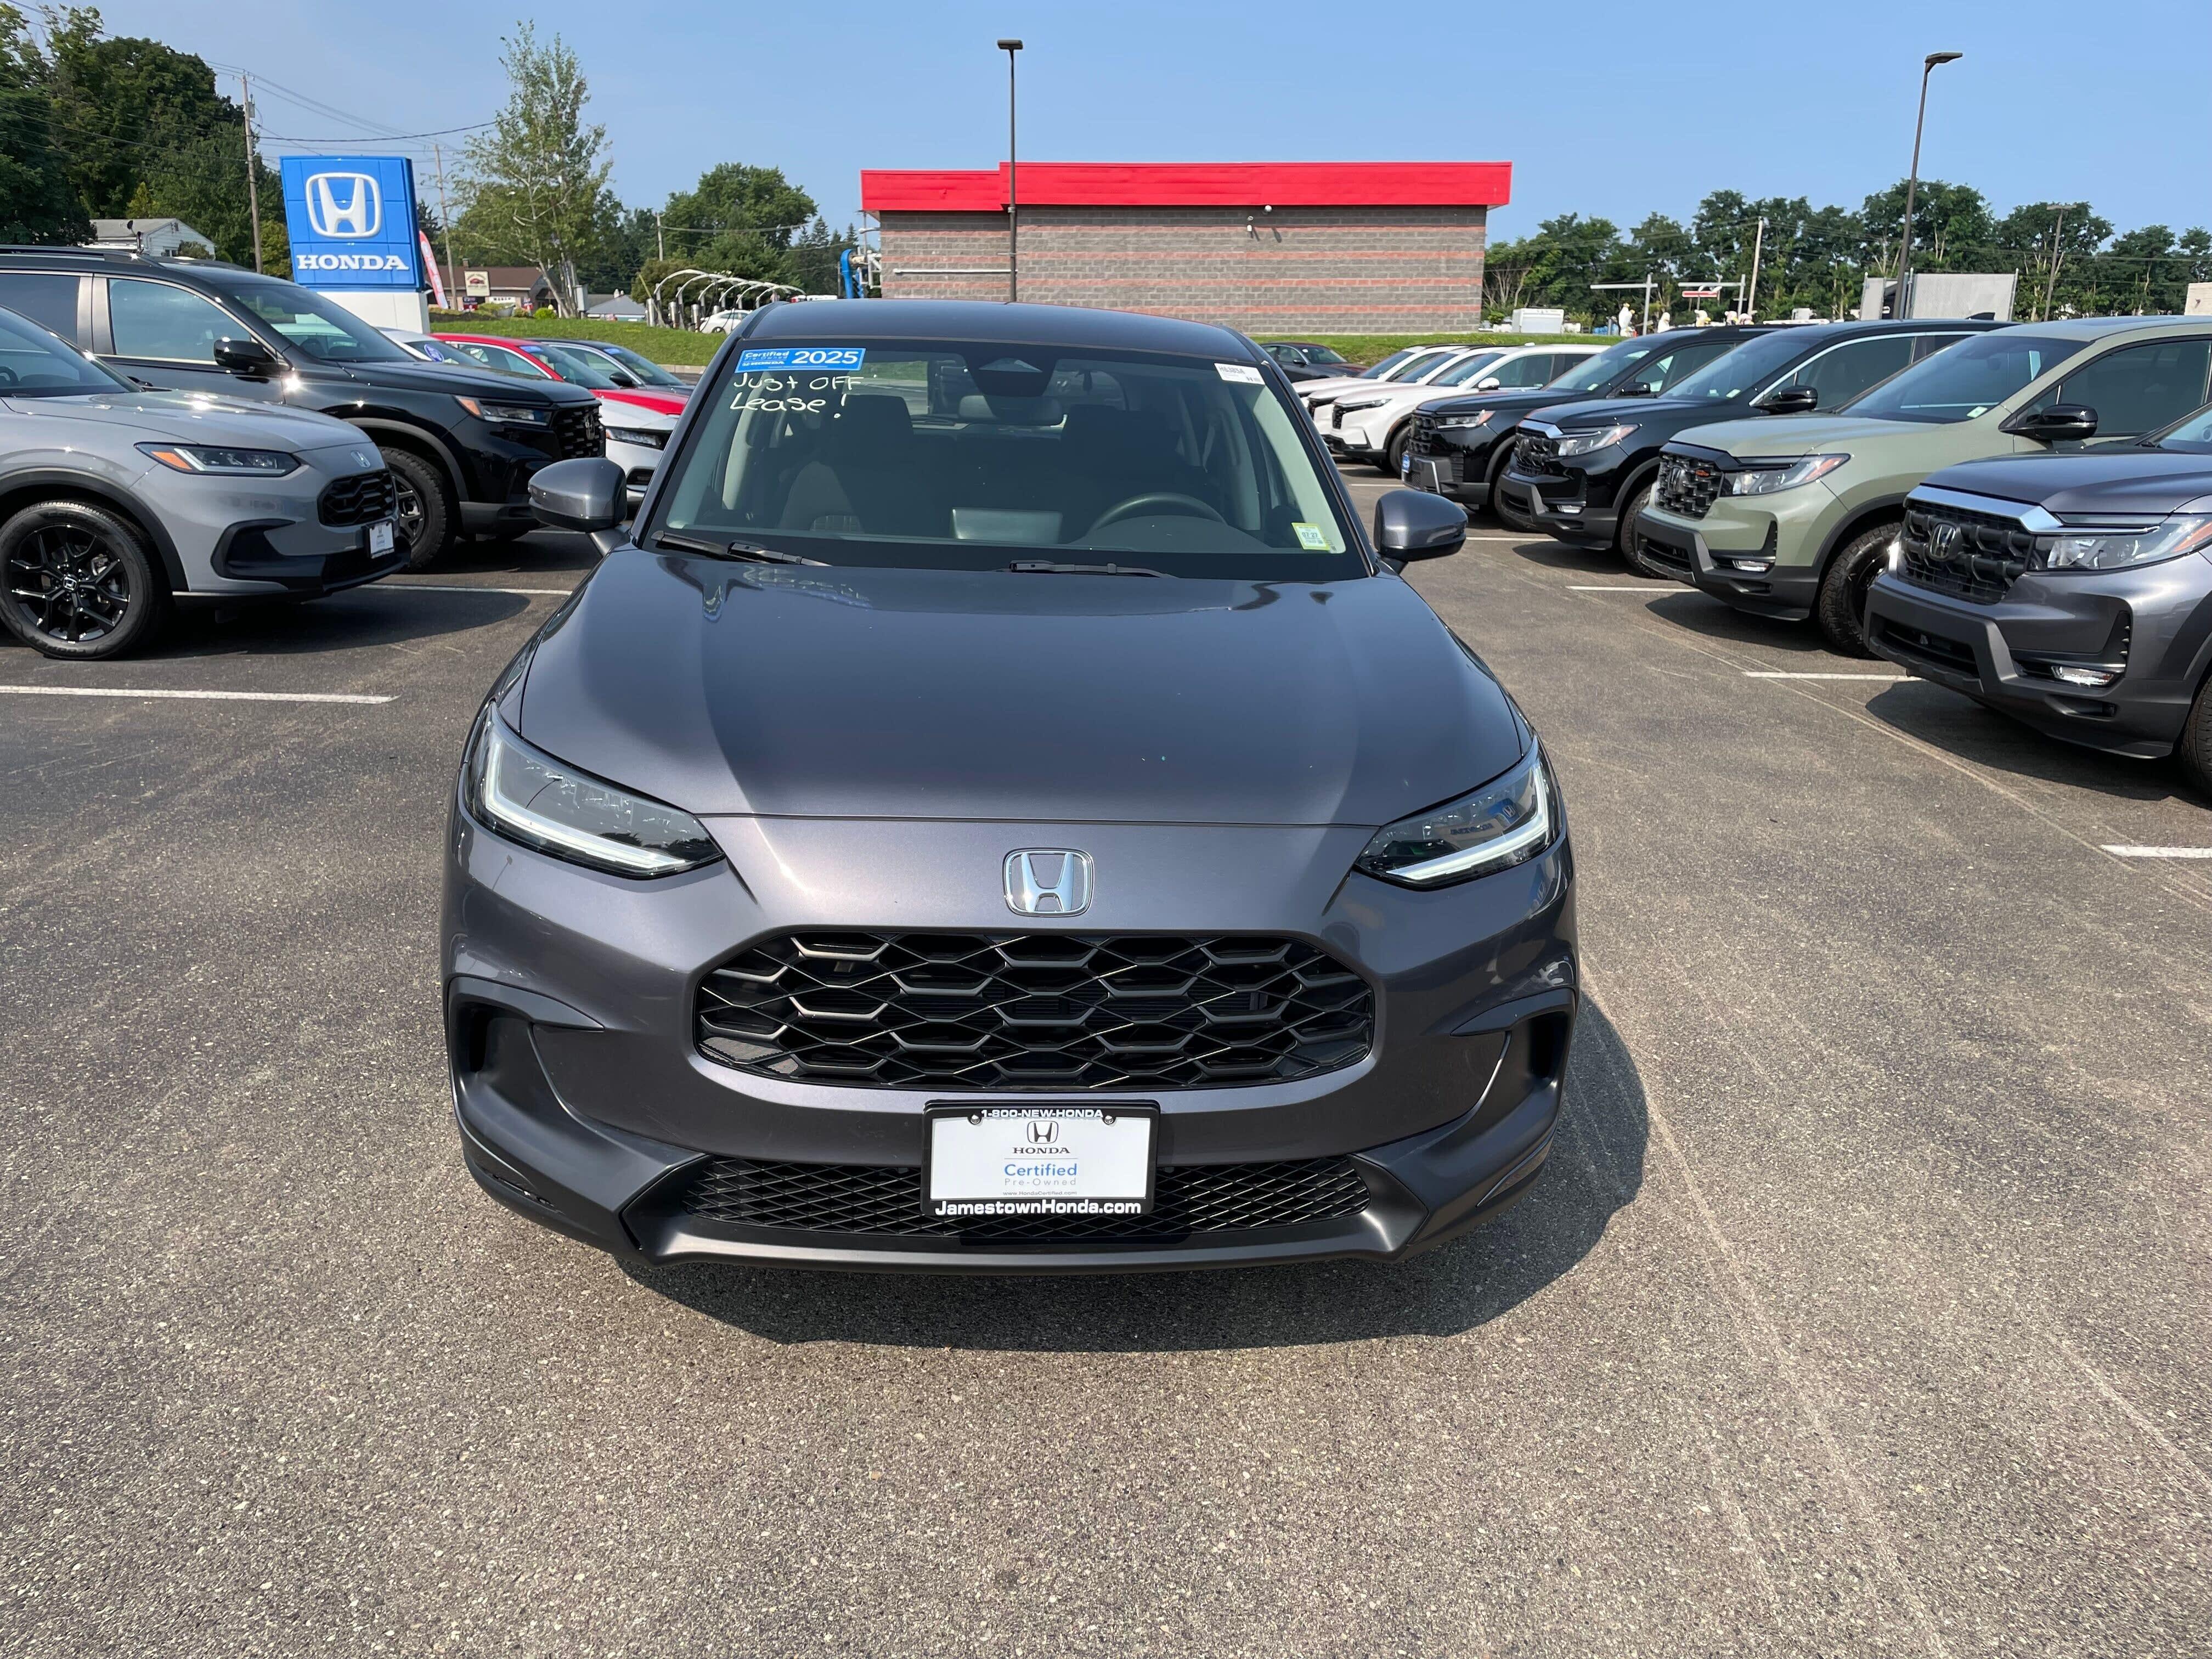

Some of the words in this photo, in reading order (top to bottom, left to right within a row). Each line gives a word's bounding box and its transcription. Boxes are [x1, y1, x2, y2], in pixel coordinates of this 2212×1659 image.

[297, 254, 409, 270] HONDA
[792, 351, 859, 364] 2025
[733, 372, 798, 391] Just
[809, 376, 864, 391] OFF
[981, 1109, 1103, 1118] 1-800-NEW-HONDA
[1005, 1163, 1077, 1176] Certified
[1005, 1178, 1076, 1186] Pre-Owned
[935, 1199, 1142, 1215] JamestownHonda.com
